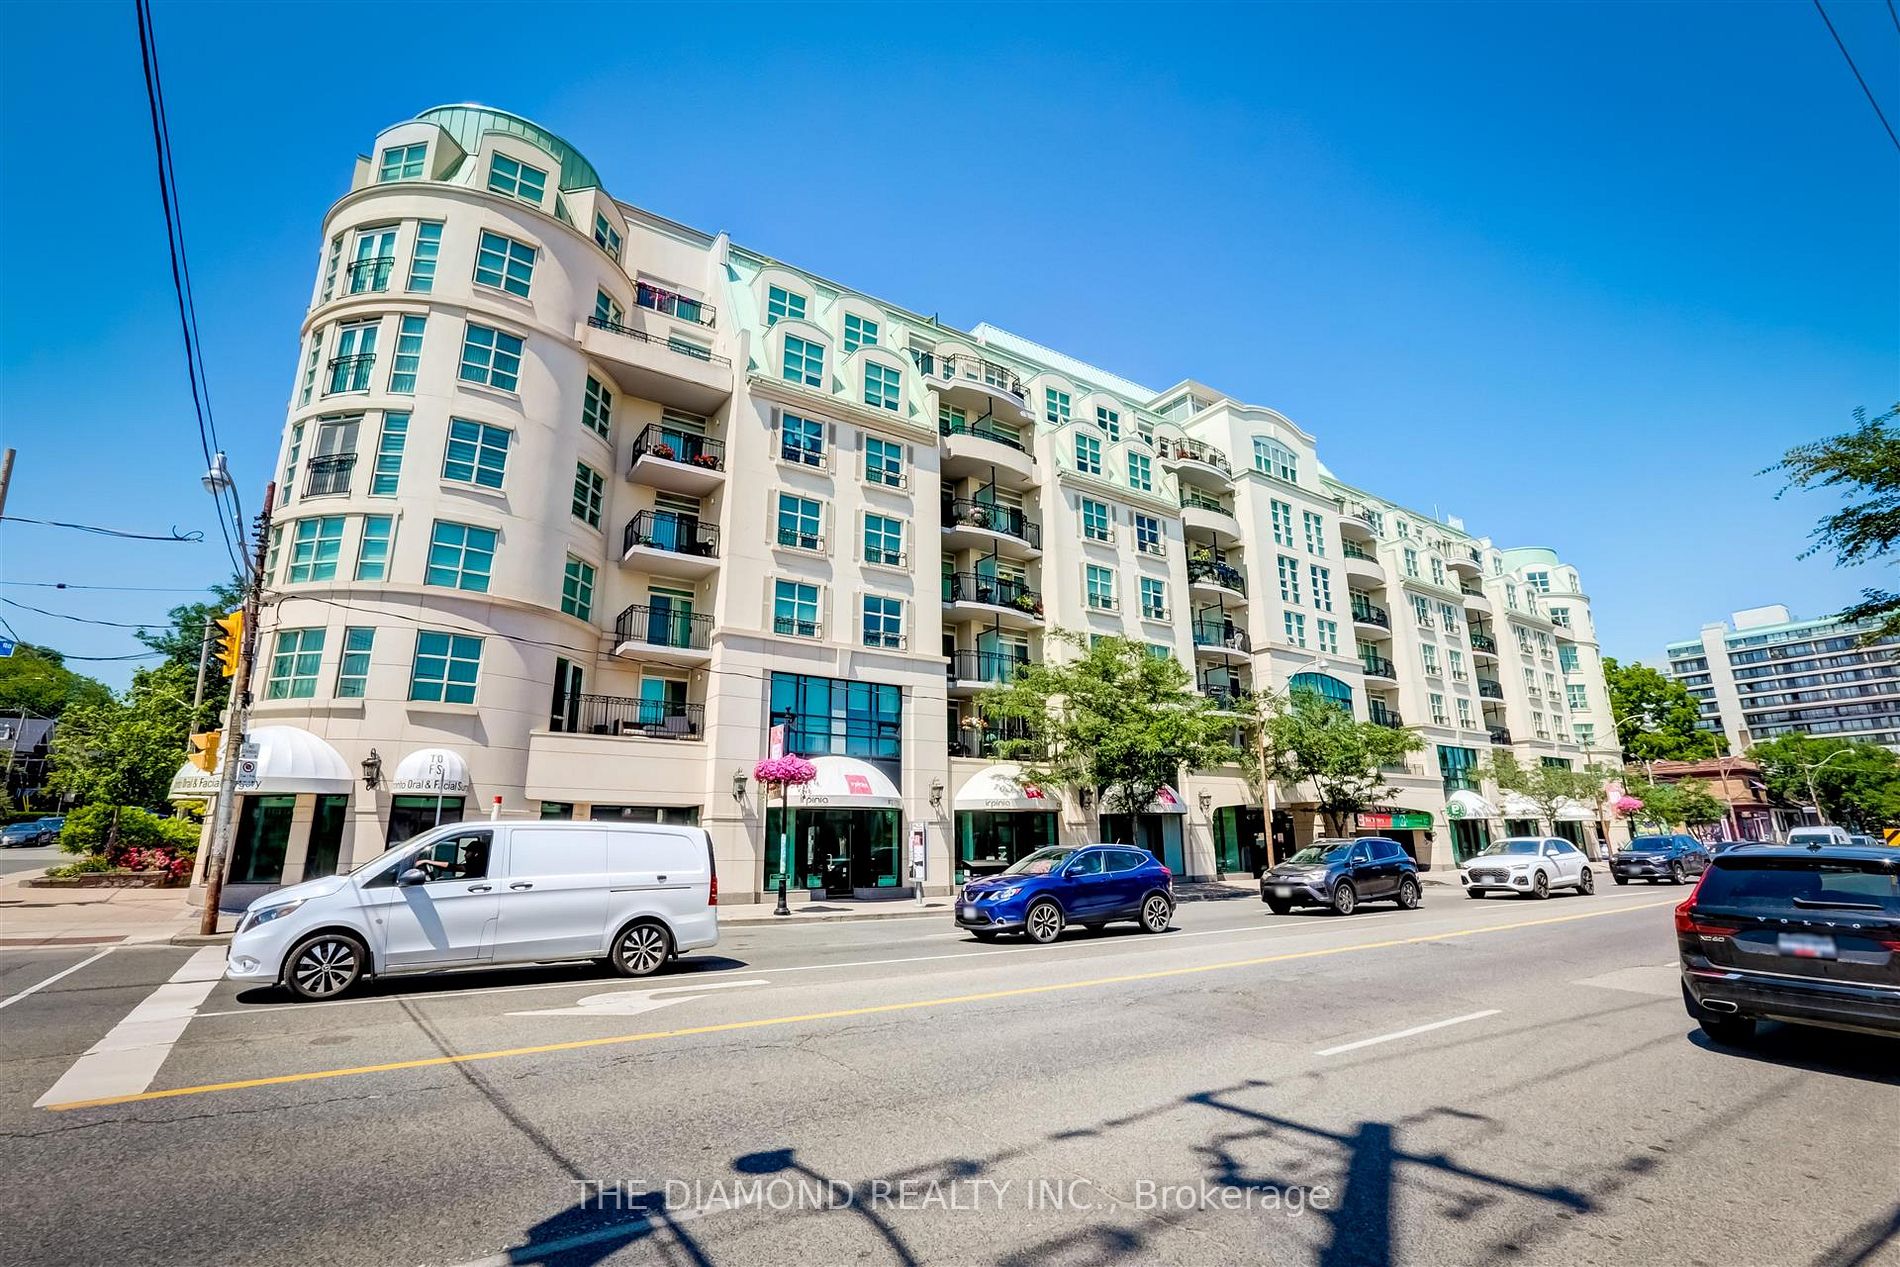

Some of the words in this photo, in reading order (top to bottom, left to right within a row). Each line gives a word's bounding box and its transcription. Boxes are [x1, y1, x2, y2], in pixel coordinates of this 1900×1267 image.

[199, 777, 221, 788] Facia
[407, 780, 424, 789] Oral
[425, 781, 431, 789] &
[1757, 916, 1861, 929] VOLVO
